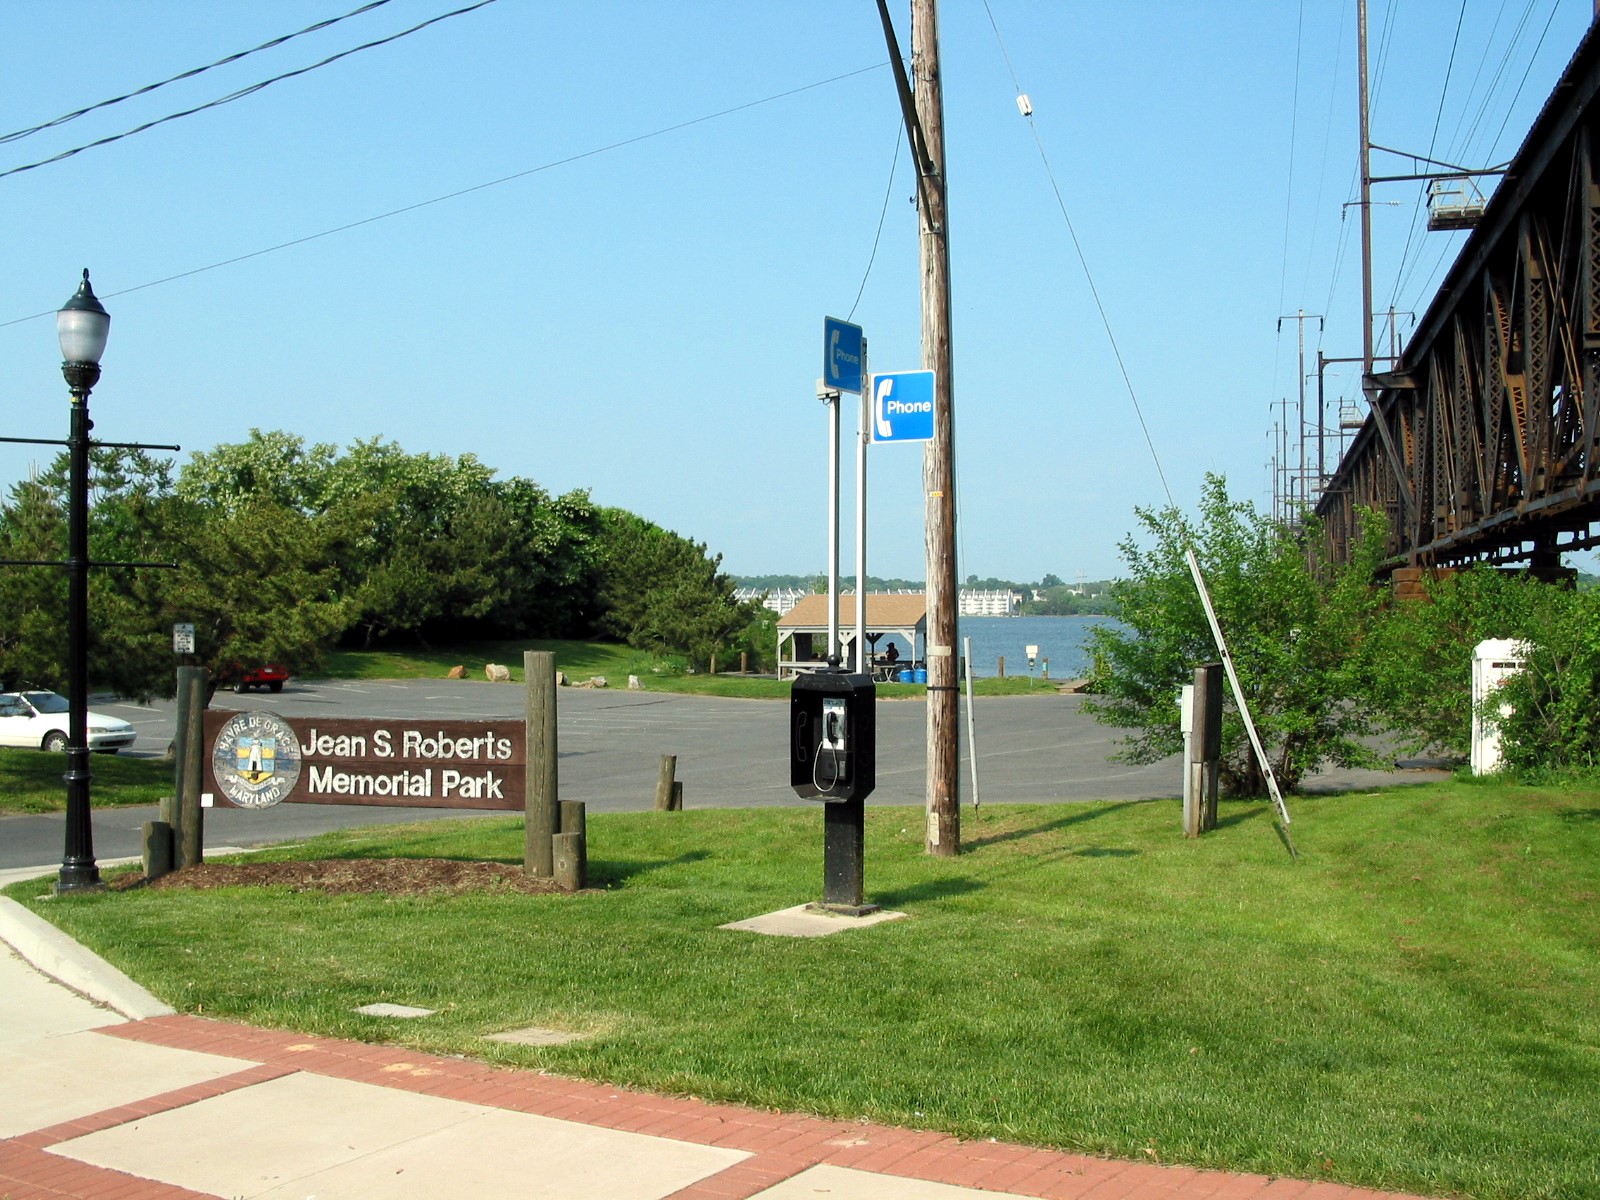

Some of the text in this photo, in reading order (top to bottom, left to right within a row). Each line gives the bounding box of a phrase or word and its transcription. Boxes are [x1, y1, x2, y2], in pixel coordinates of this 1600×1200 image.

[836, 349, 859, 364] Phone
[887, 400, 932, 415] Phone
[219, 716, 294, 753] HAVRE DE GRACE
[301, 729, 512, 760] Jean S. Roberts
[229, 785, 280, 805] MARYLAND
[308, 766, 504, 799] Memorial Park
